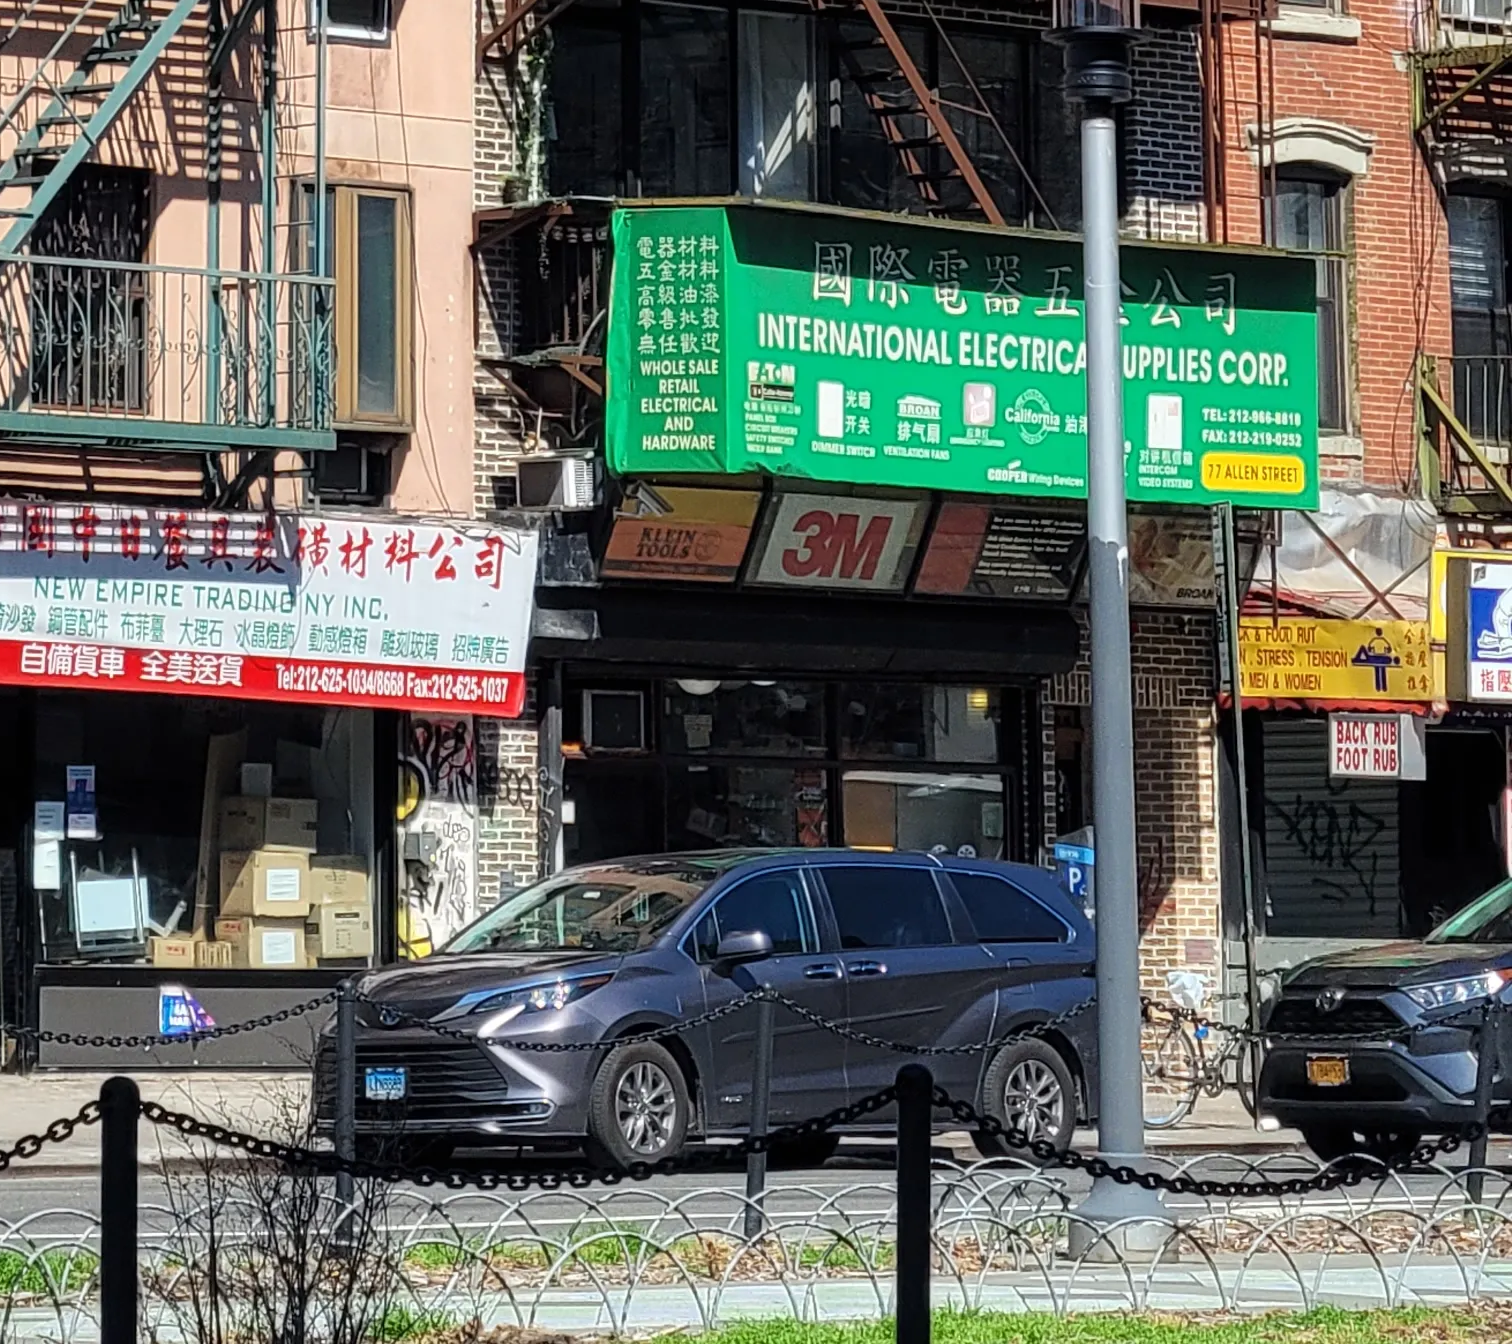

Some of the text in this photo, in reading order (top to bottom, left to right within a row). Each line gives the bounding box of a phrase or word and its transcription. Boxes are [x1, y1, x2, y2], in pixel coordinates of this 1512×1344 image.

[637, 234, 719, 259] 電器材料
[637, 260, 719, 282] 五金材料
[637, 283, 719, 306] 高級油漆
[637, 307, 720, 331] 零售批發
[637, 332, 720, 355] 無任歡迎
[759, 312, 1289, 387] INTERNATIONAL ELECTRICA UPPLIES CORP.
[640, 359, 719, 375] WHOLE SALE
[659, 379, 700, 394] RETAIL
[641, 398, 718, 413] ELECTRICAL
[899, 403, 940, 417] BROAN
[1202, 408, 1227, 422] TEL:
[664, 416, 694, 431] AND
[845, 415, 871, 435] 开关
[1005, 407, 1060, 426] California
[642, 435, 715, 451] HARDWARE
[1202, 429, 1302, 448] FAX: 212-219-0252
[811, 440, 876, 458] DIMMER SWITCH
[883, 445, 951, 461] VENTILATION FANS
[987, 468, 1028, 483] COOPER
[1029, 472, 1052, 487] Wiring
[1139, 464, 1178, 475] INTERCOM
[1225, 464, 1259, 481] ALLEN
[1262, 466, 1298, 483] STREET
[1138, 477, 1193, 489] VIDEO SYSTEMS
[641, 527, 697, 542] KLEIN
[636, 543, 691, 559] TOOLS
[781, 509, 894, 581] 3M
[34, 575, 388, 621] NEW EMPIRE TRADING NY INC.
[178, 618, 223, 647] 大理石
[381, 628, 440, 660] 雕刻玻璃
[452, 632, 510, 665] 招牌廣告
[20, 643, 243, 686] 自備貨車 全美送貨
[1256, 648, 1295, 666] STRESS
[1306, 650, 1348, 668] TENSION
[406, 672, 509, 703] Fax:212-625-1037
[1249, 672, 1269, 689] MEN
[1273, 673, 1279, 689] &
[1285, 673, 1321, 690] WOMEN
[1336, 721, 1397, 745] BACK RUB
[1336, 748, 1397, 771] FOOT RUB
